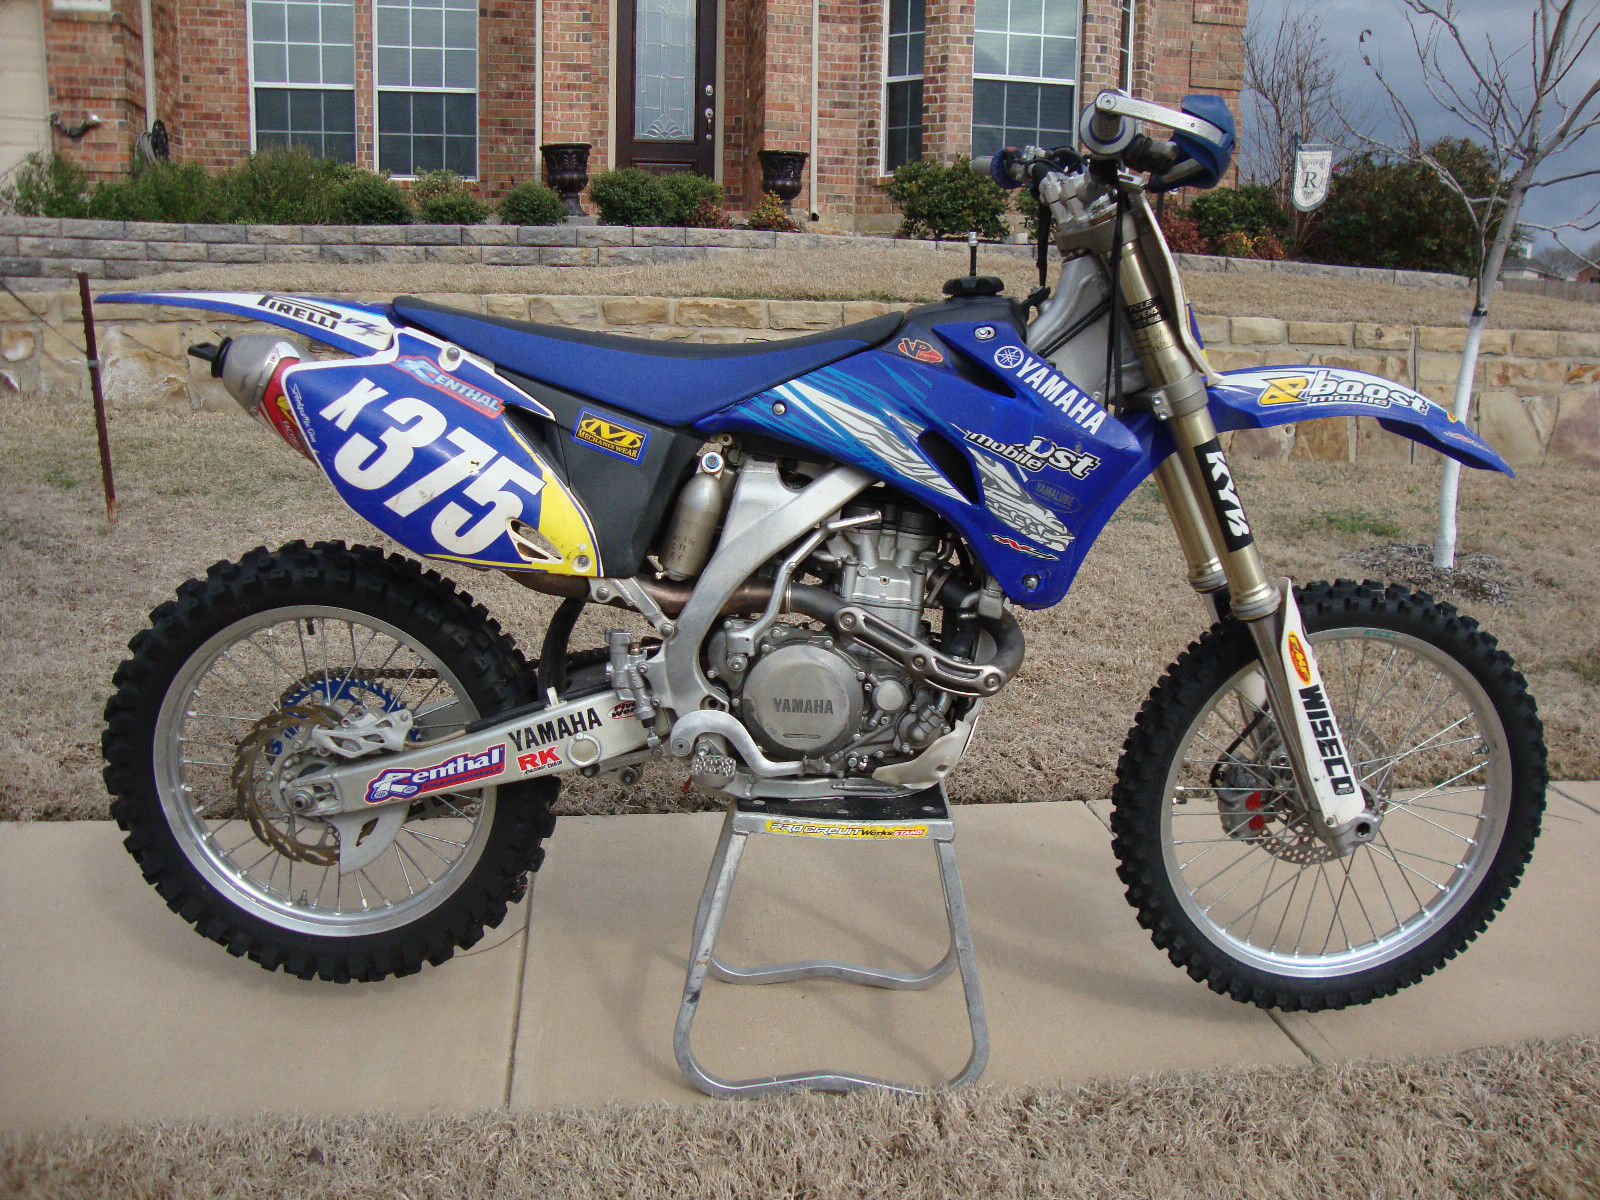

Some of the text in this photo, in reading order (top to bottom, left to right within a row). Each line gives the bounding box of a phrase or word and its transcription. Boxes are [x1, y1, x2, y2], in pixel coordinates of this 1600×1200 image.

[1303, 171, 1317, 188] R
[257, 295, 342, 330] PIRELLI
[1015, 356, 1108, 435] YAMAHA
[1309, 370, 1430, 416] boost
[1311, 394, 1390, 407] mobile
[577, 430, 638, 458] MECHANIX WEAR
[965, 432, 1044, 470] mobile
[1205, 451, 1250, 537] KYB
[773, 697, 834, 715] YAMAHA
[507, 707, 603, 752] YAMAHA
[517, 746, 561, 771] RK
[770, 822, 803, 833] PRO
[803, 825, 863, 836] CIRCUIT
